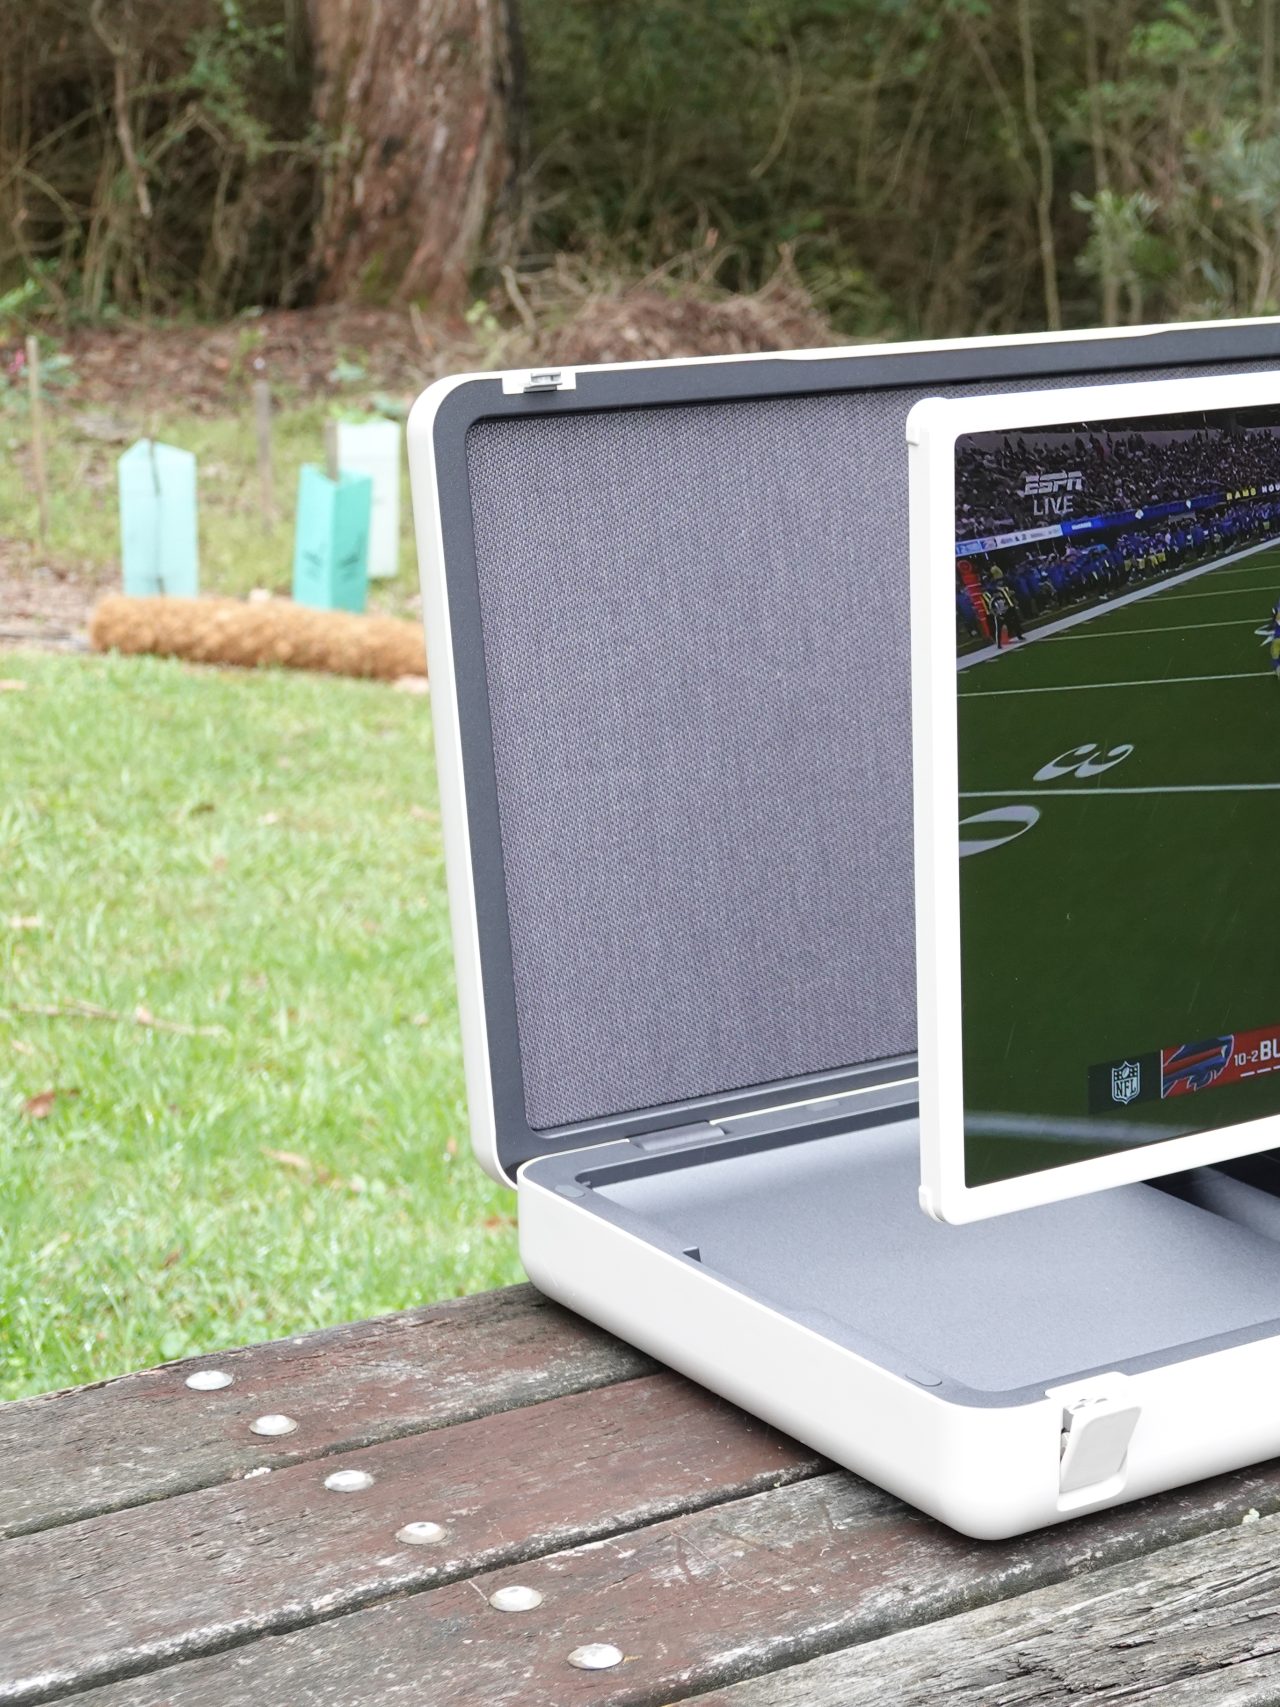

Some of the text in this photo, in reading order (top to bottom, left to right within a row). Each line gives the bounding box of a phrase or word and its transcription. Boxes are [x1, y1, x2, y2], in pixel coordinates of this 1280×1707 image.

[1024, 471, 1084, 496] ESPN
[1033, 495, 1075, 517] LIVE
[1234, 1049, 1259, 1067] 10-2
[1114, 1077, 1137, 1097] NFL
